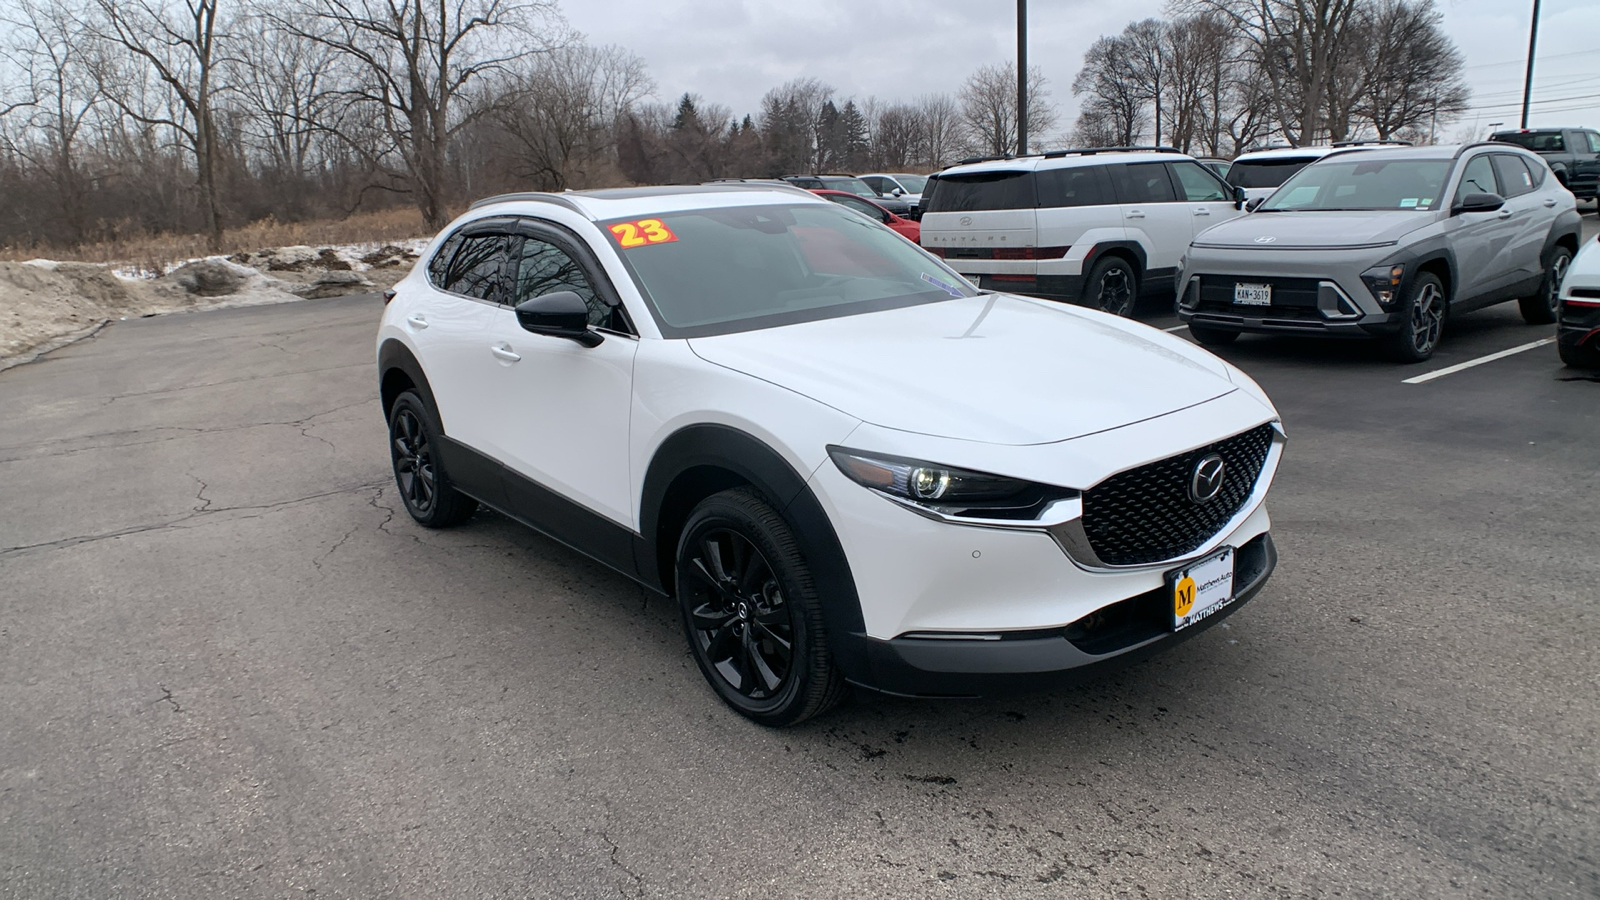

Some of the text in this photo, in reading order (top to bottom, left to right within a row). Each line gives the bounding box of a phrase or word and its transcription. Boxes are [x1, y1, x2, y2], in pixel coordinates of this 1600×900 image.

[611, 219, 671, 247] 23
[1197, 577, 1220, 593] Matthews
[1221, 571, 1233, 581] Auto
[1177, 585, 1192, 610] M
[1190, 600, 1224, 626] MATTHEWS
